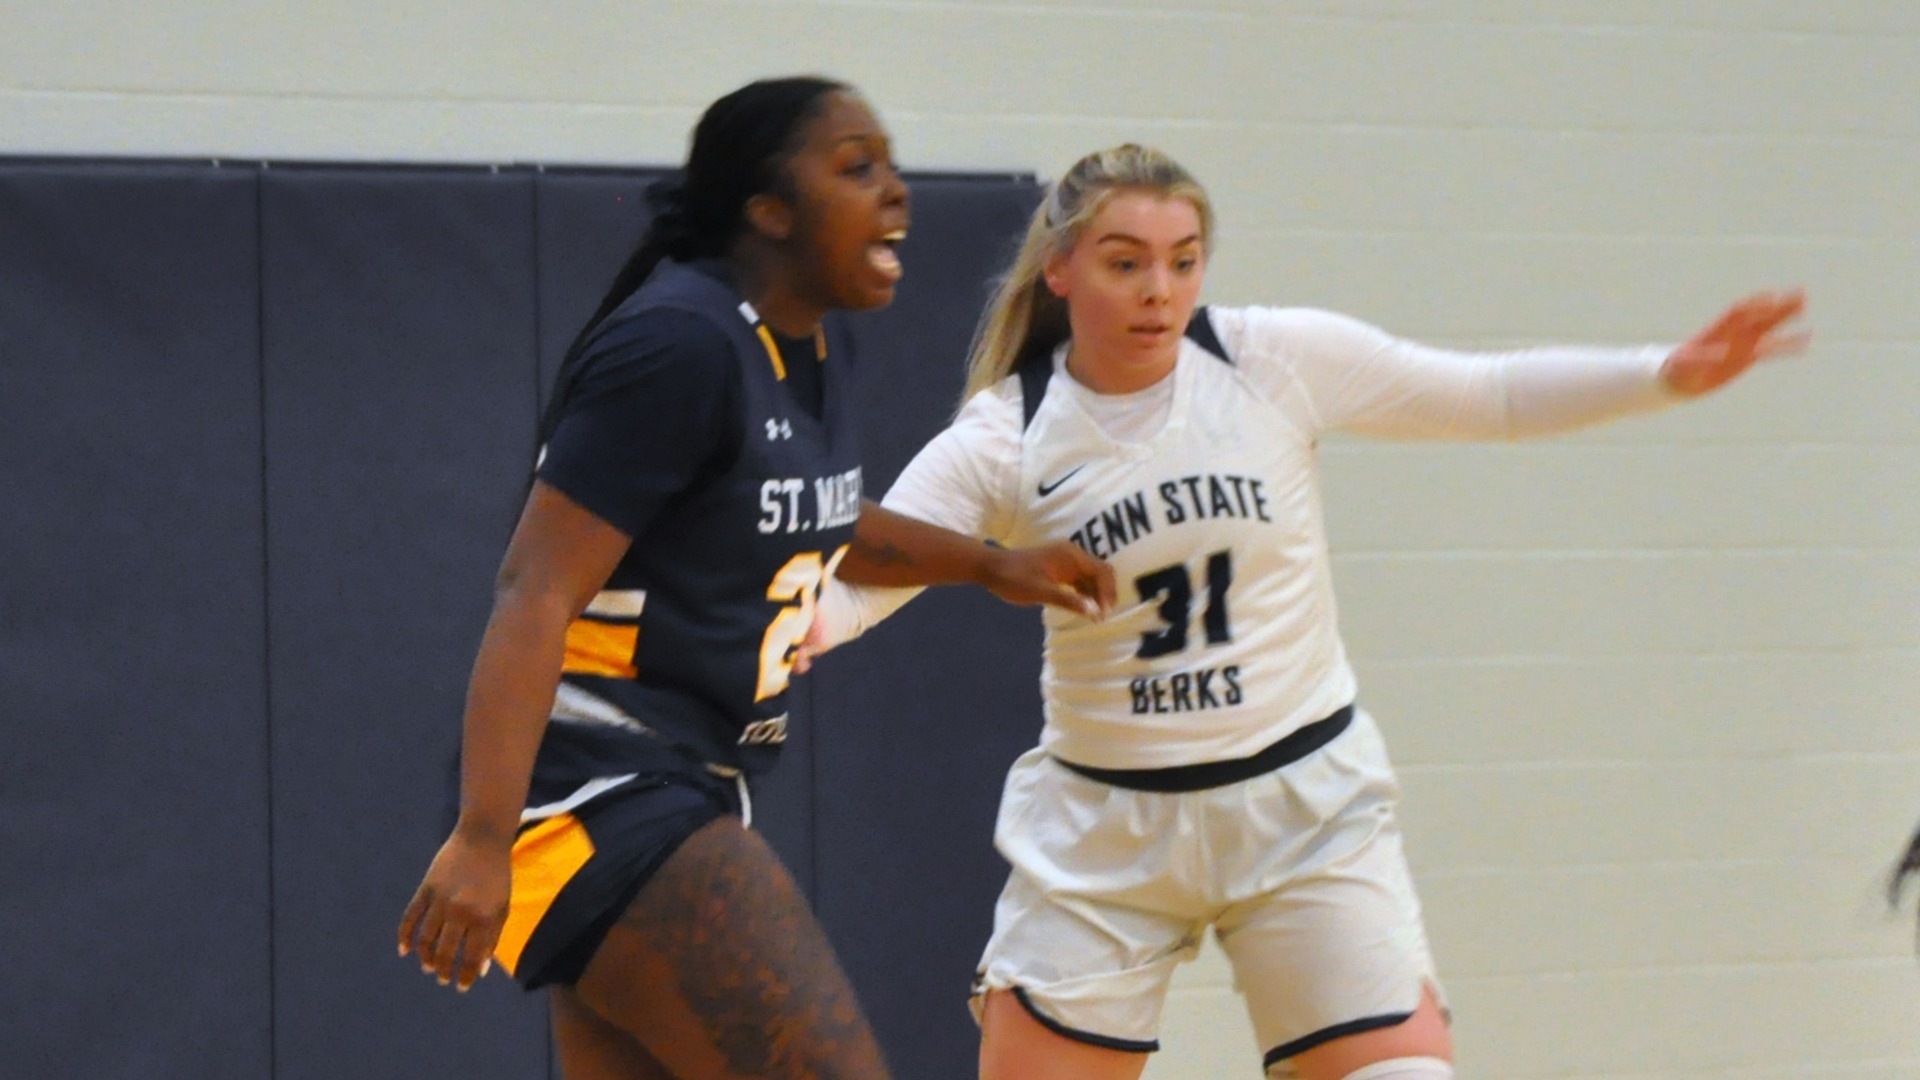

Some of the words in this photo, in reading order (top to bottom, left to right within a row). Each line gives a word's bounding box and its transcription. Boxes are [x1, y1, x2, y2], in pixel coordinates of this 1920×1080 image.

[758, 478, 811, 533] ST.
[1158, 474, 1271, 523] STATE
[1133, 547, 1232, 661] 31
[1130, 664, 1244, 715] BERKS
